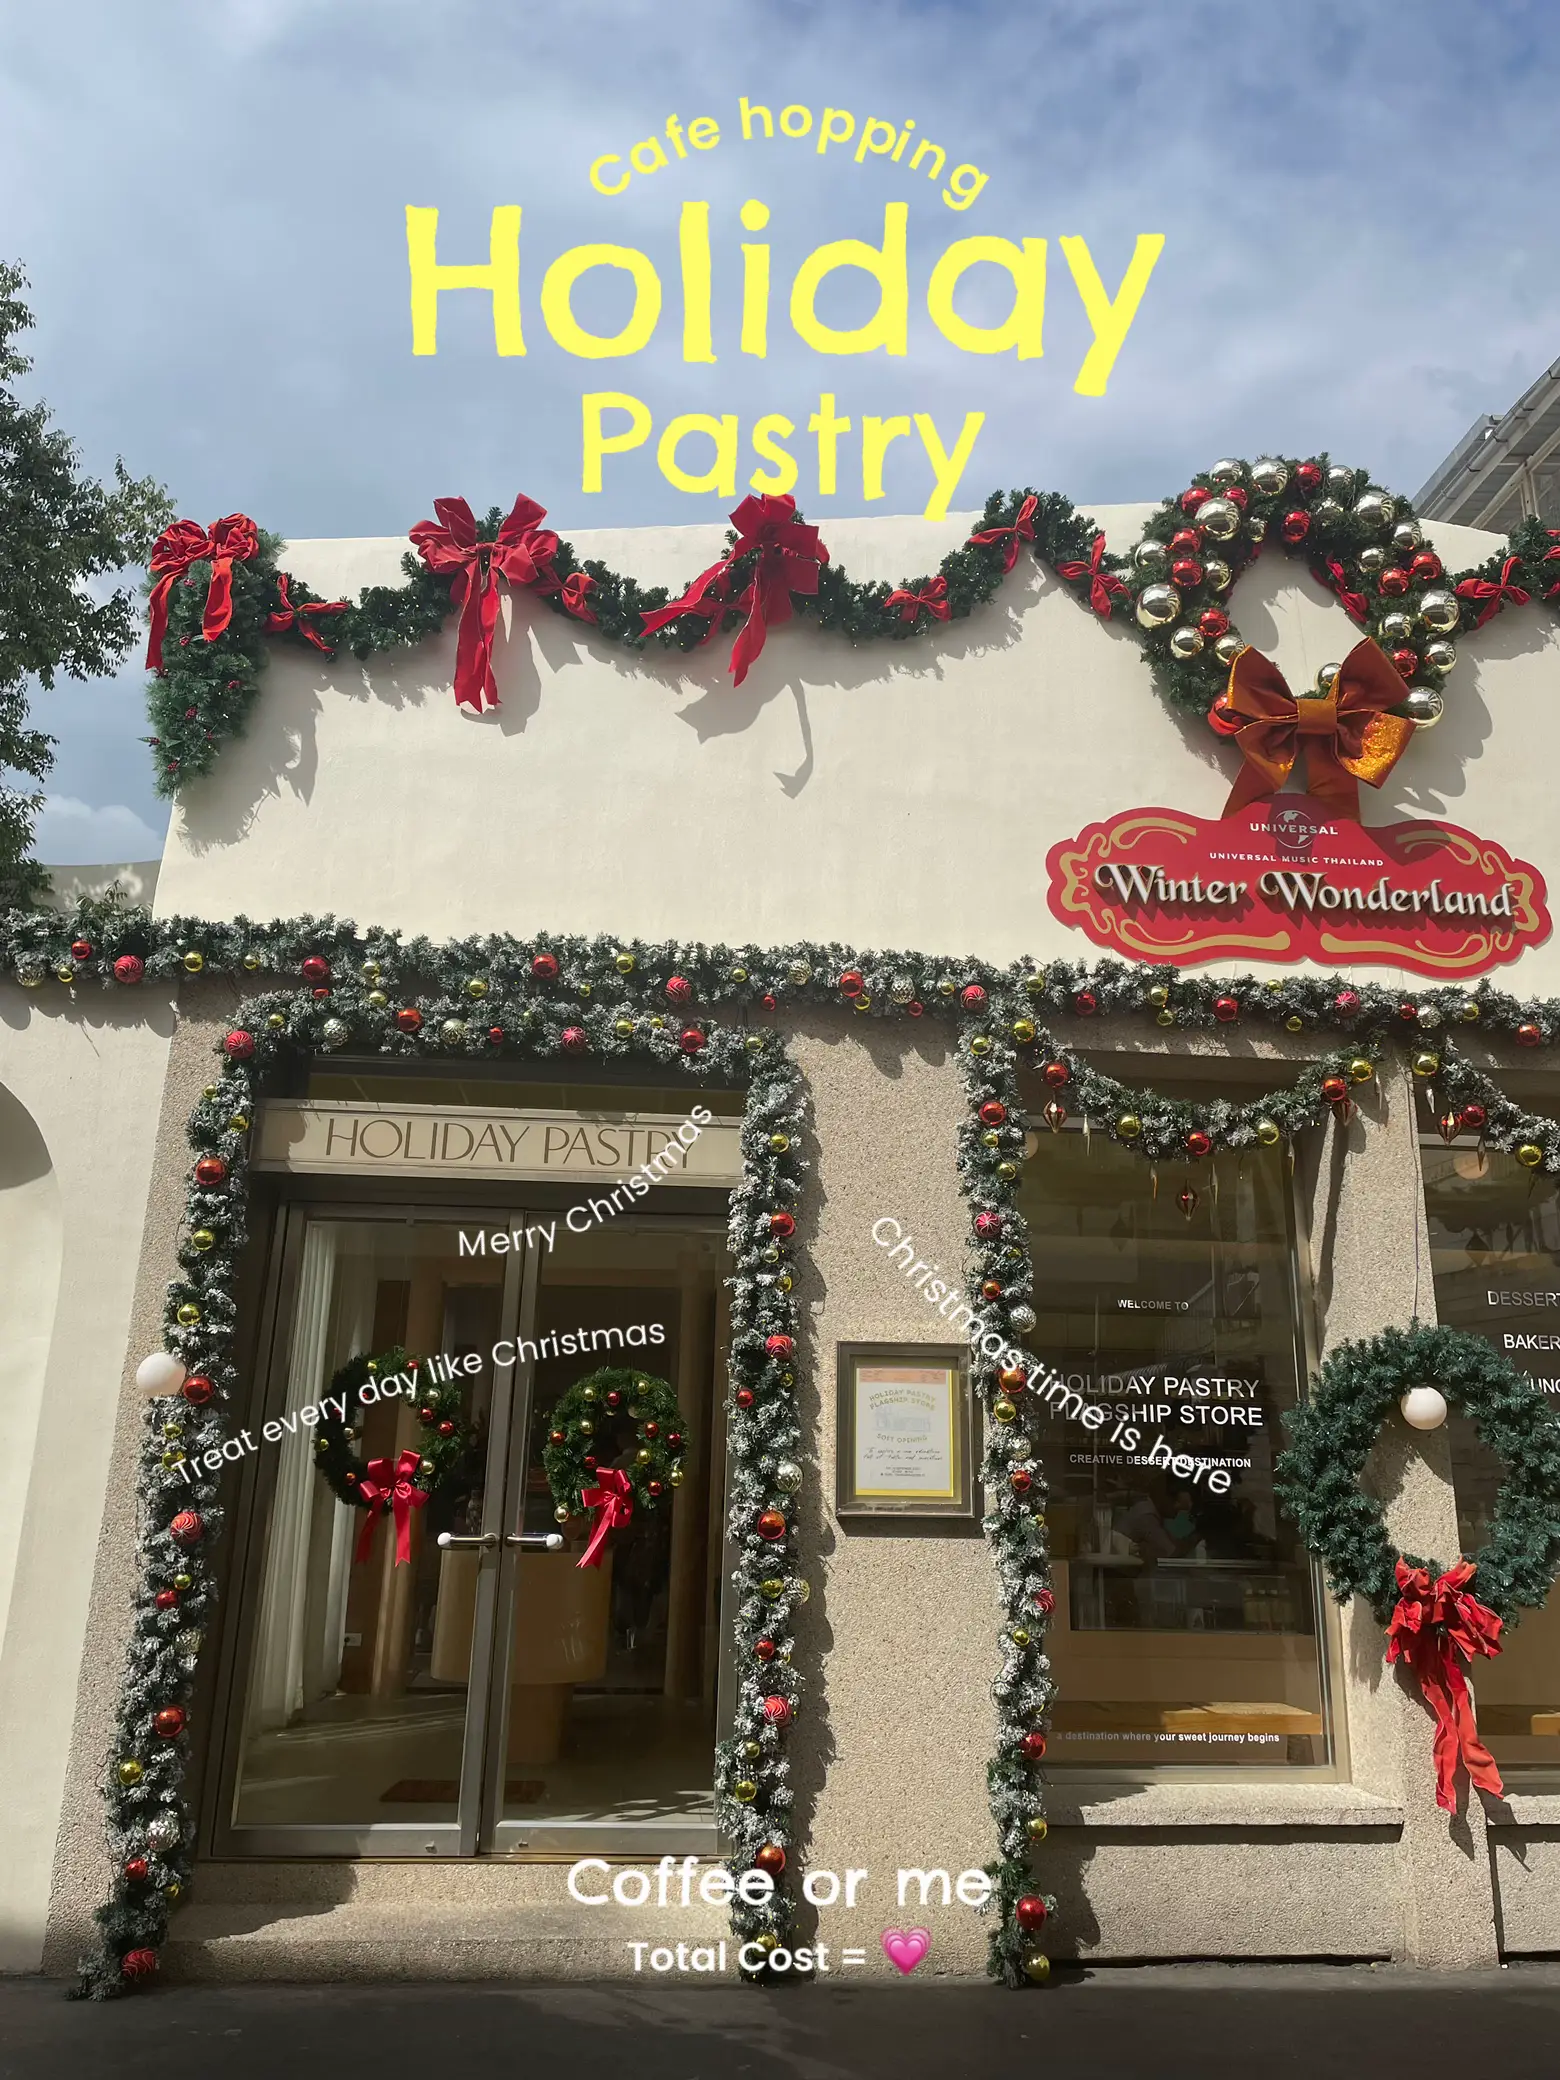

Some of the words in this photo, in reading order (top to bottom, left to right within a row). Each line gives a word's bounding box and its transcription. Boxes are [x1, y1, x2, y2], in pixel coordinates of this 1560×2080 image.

[1250, 822, 1339, 836] UNIVERSAL
[1209, 852, 1277, 863] UNIVERSAL
[1281, 855, 1319, 864] MUSIC
[1323, 857, 1384, 867] THAILAND
[1094, 862, 1248, 906] Winter
[1260, 870, 1517, 918] Wonderland
[325, 1117, 530, 1163] HOLIDAY
[543, 1126, 701, 1170] PASTRY
[1117, 1299, 1172, 1310] WELCOME
[1175, 1301, 1189, 1311] TO
[1050, 1373, 1156, 1396] HOLIDAY
[1163, 1376, 1260, 1398] PASTRY
[1050, 1401, 1172, 1424] FLAGSHIP
[1179, 1405, 1264, 1427] STORE
[1069, 1454, 1123, 1465] CREATIVE
[1065, 1731, 1119, 1741] destination
[1122, 1732, 1151, 1741] where
[1154, 1733, 1176, 1743] your
[1178, 1733, 1207, 1742] sweet
[1208, 1733, 1245, 1744] journey
[1247, 1733, 1280, 1744] begins
